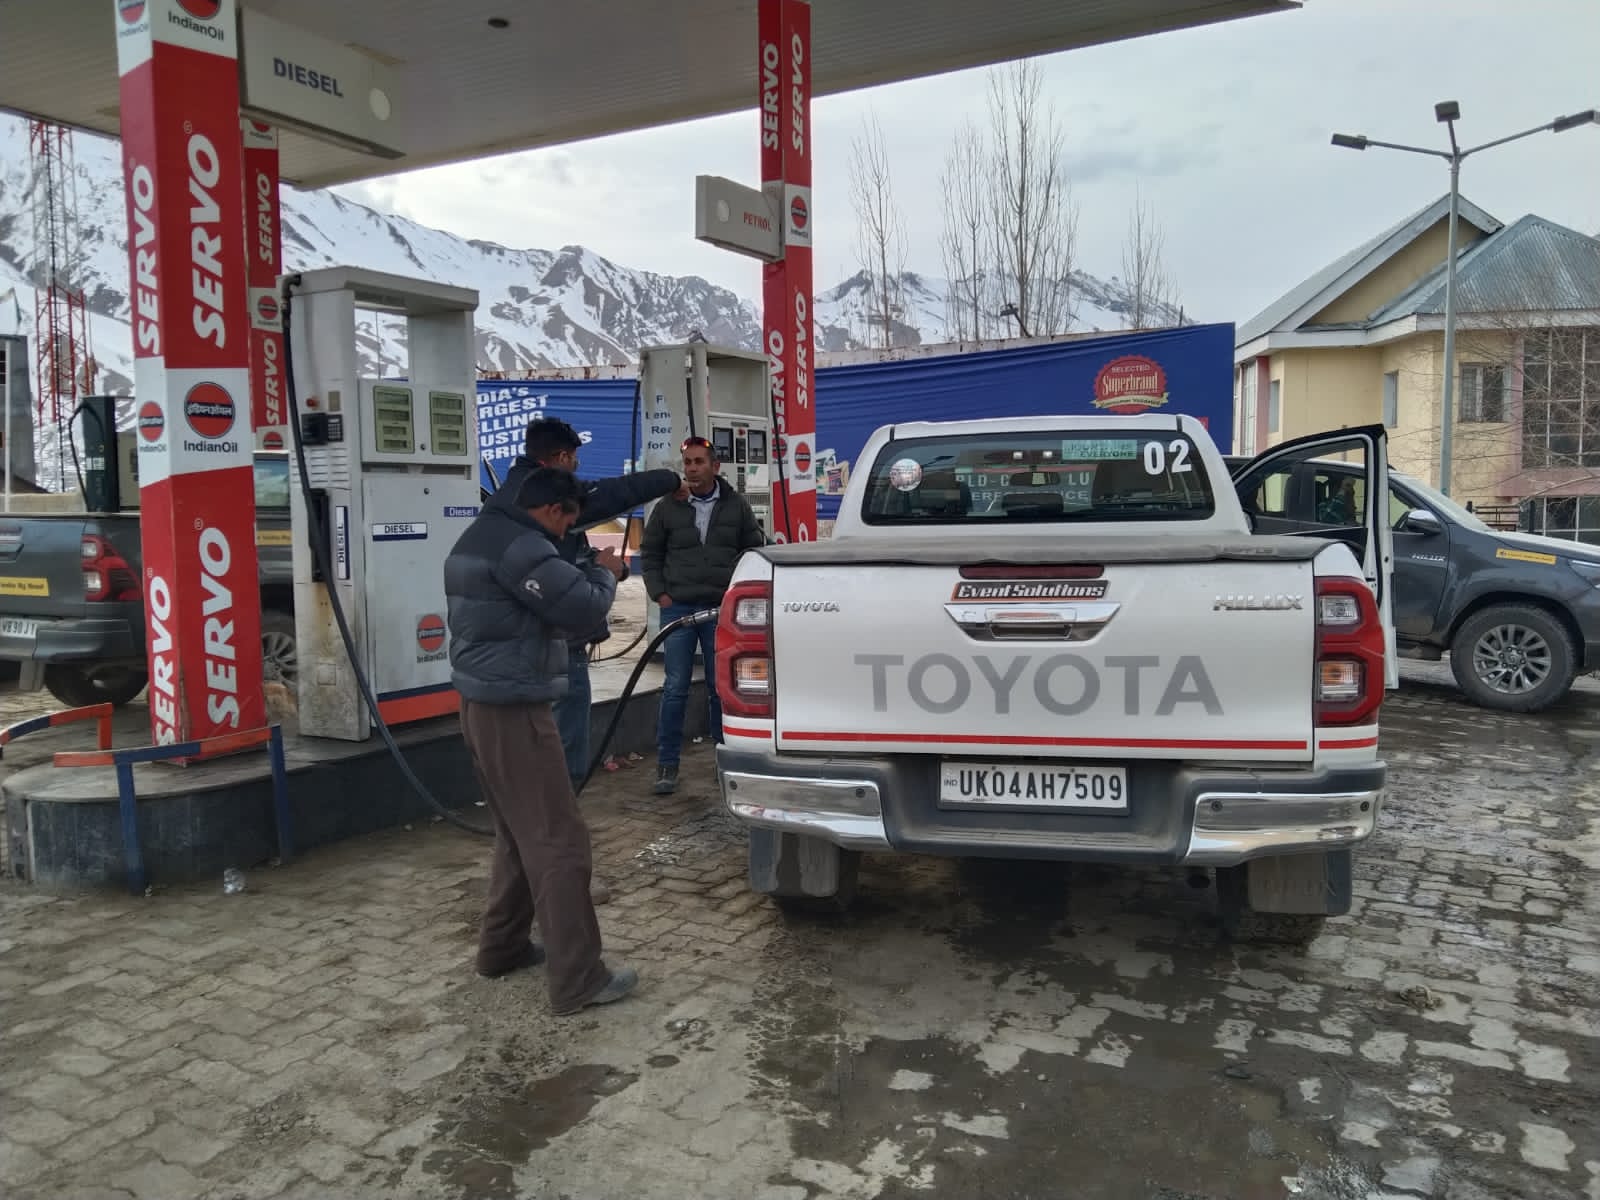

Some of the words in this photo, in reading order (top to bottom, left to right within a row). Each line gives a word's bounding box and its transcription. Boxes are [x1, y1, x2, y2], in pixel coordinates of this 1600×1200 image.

[168, 10, 225, 41] IndianOil
[273, 57, 344, 98] DIESEL
[763, 43, 779, 151] SERVO
[791, 33, 803, 157] SERVO
[257, 173, 273, 264] SERVO
[743, 212, 772, 233] PETROL
[187, 133, 226, 349] SERVO
[132, 165, 160, 355] SERVO
[796, 291, 808, 409] SERVO
[264, 338, 280, 425] SERVO
[769, 329, 786, 433] SERVO
[1102, 371, 1158, 396] Superbrand
[1111, 364, 1151, 373] SELECTED
[476, 387, 529, 405] DIA'S
[479, 394, 549, 419] RGEST
[184, 440, 238, 453] IndianOil
[648, 441, 664, 450] for
[1143, 439, 1192, 475] 02
[449, 507, 474, 516] Diesel
[384, 524, 415, 534] DIESEL
[783, 600, 841, 613] TOYOTA
[1213, 593, 1304, 611] HILUX
[199, 527, 240, 729] SERVO
[150, 576, 177, 747] SERVO
[854, 653, 1225, 716] TOYOTA
[943, 778, 958, 787] IND
[960, 769, 1122, 801] UK04AH7509
